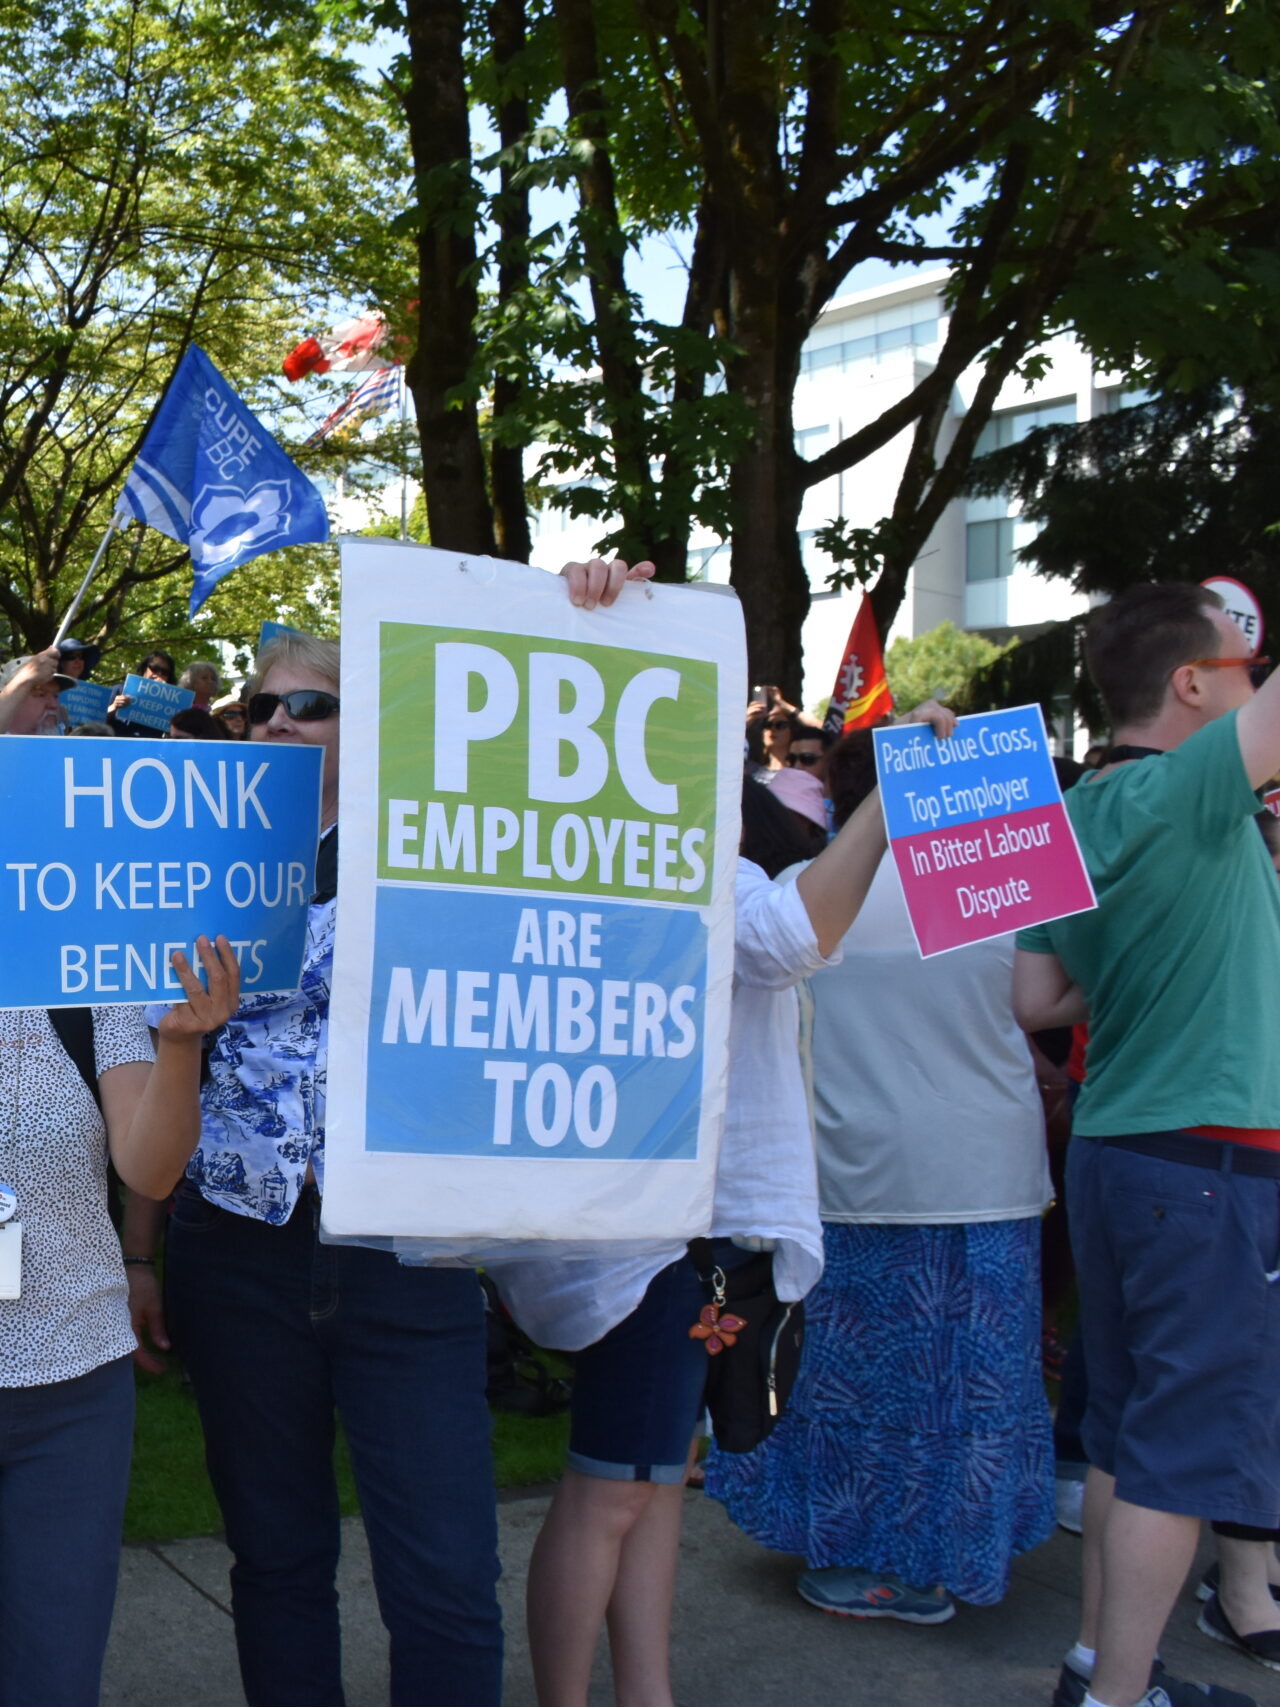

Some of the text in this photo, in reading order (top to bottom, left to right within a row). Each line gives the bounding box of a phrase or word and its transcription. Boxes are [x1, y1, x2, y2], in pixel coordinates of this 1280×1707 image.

[205, 387, 262, 465] CUPE
[205, 438, 245, 480] BC
[128, 709, 170, 728] BENEFIT
[137, 680, 182, 704] HONK
[140, 698, 163, 712] KEEP
[164, 706, 178, 717] OU
[434, 642, 681, 814] PBC
[882, 727, 1038, 774] Pacific Blue Cross,
[64, 757, 272, 830] HONK
[905, 776, 1030, 827] Top Employer
[387, 799, 707, 893] EMPLOYEES
[910, 822, 1052, 876] In Bitter Labour
[6, 861, 307, 911] TO KEEP OUR
[956, 877, 1032, 918] Dispute
[512, 908, 601, 968] ARE
[60, 939, 267, 993] BENEFTS
[381, 967, 696, 1059] MEMBERS
[483, 1060, 617, 1149] TOO
